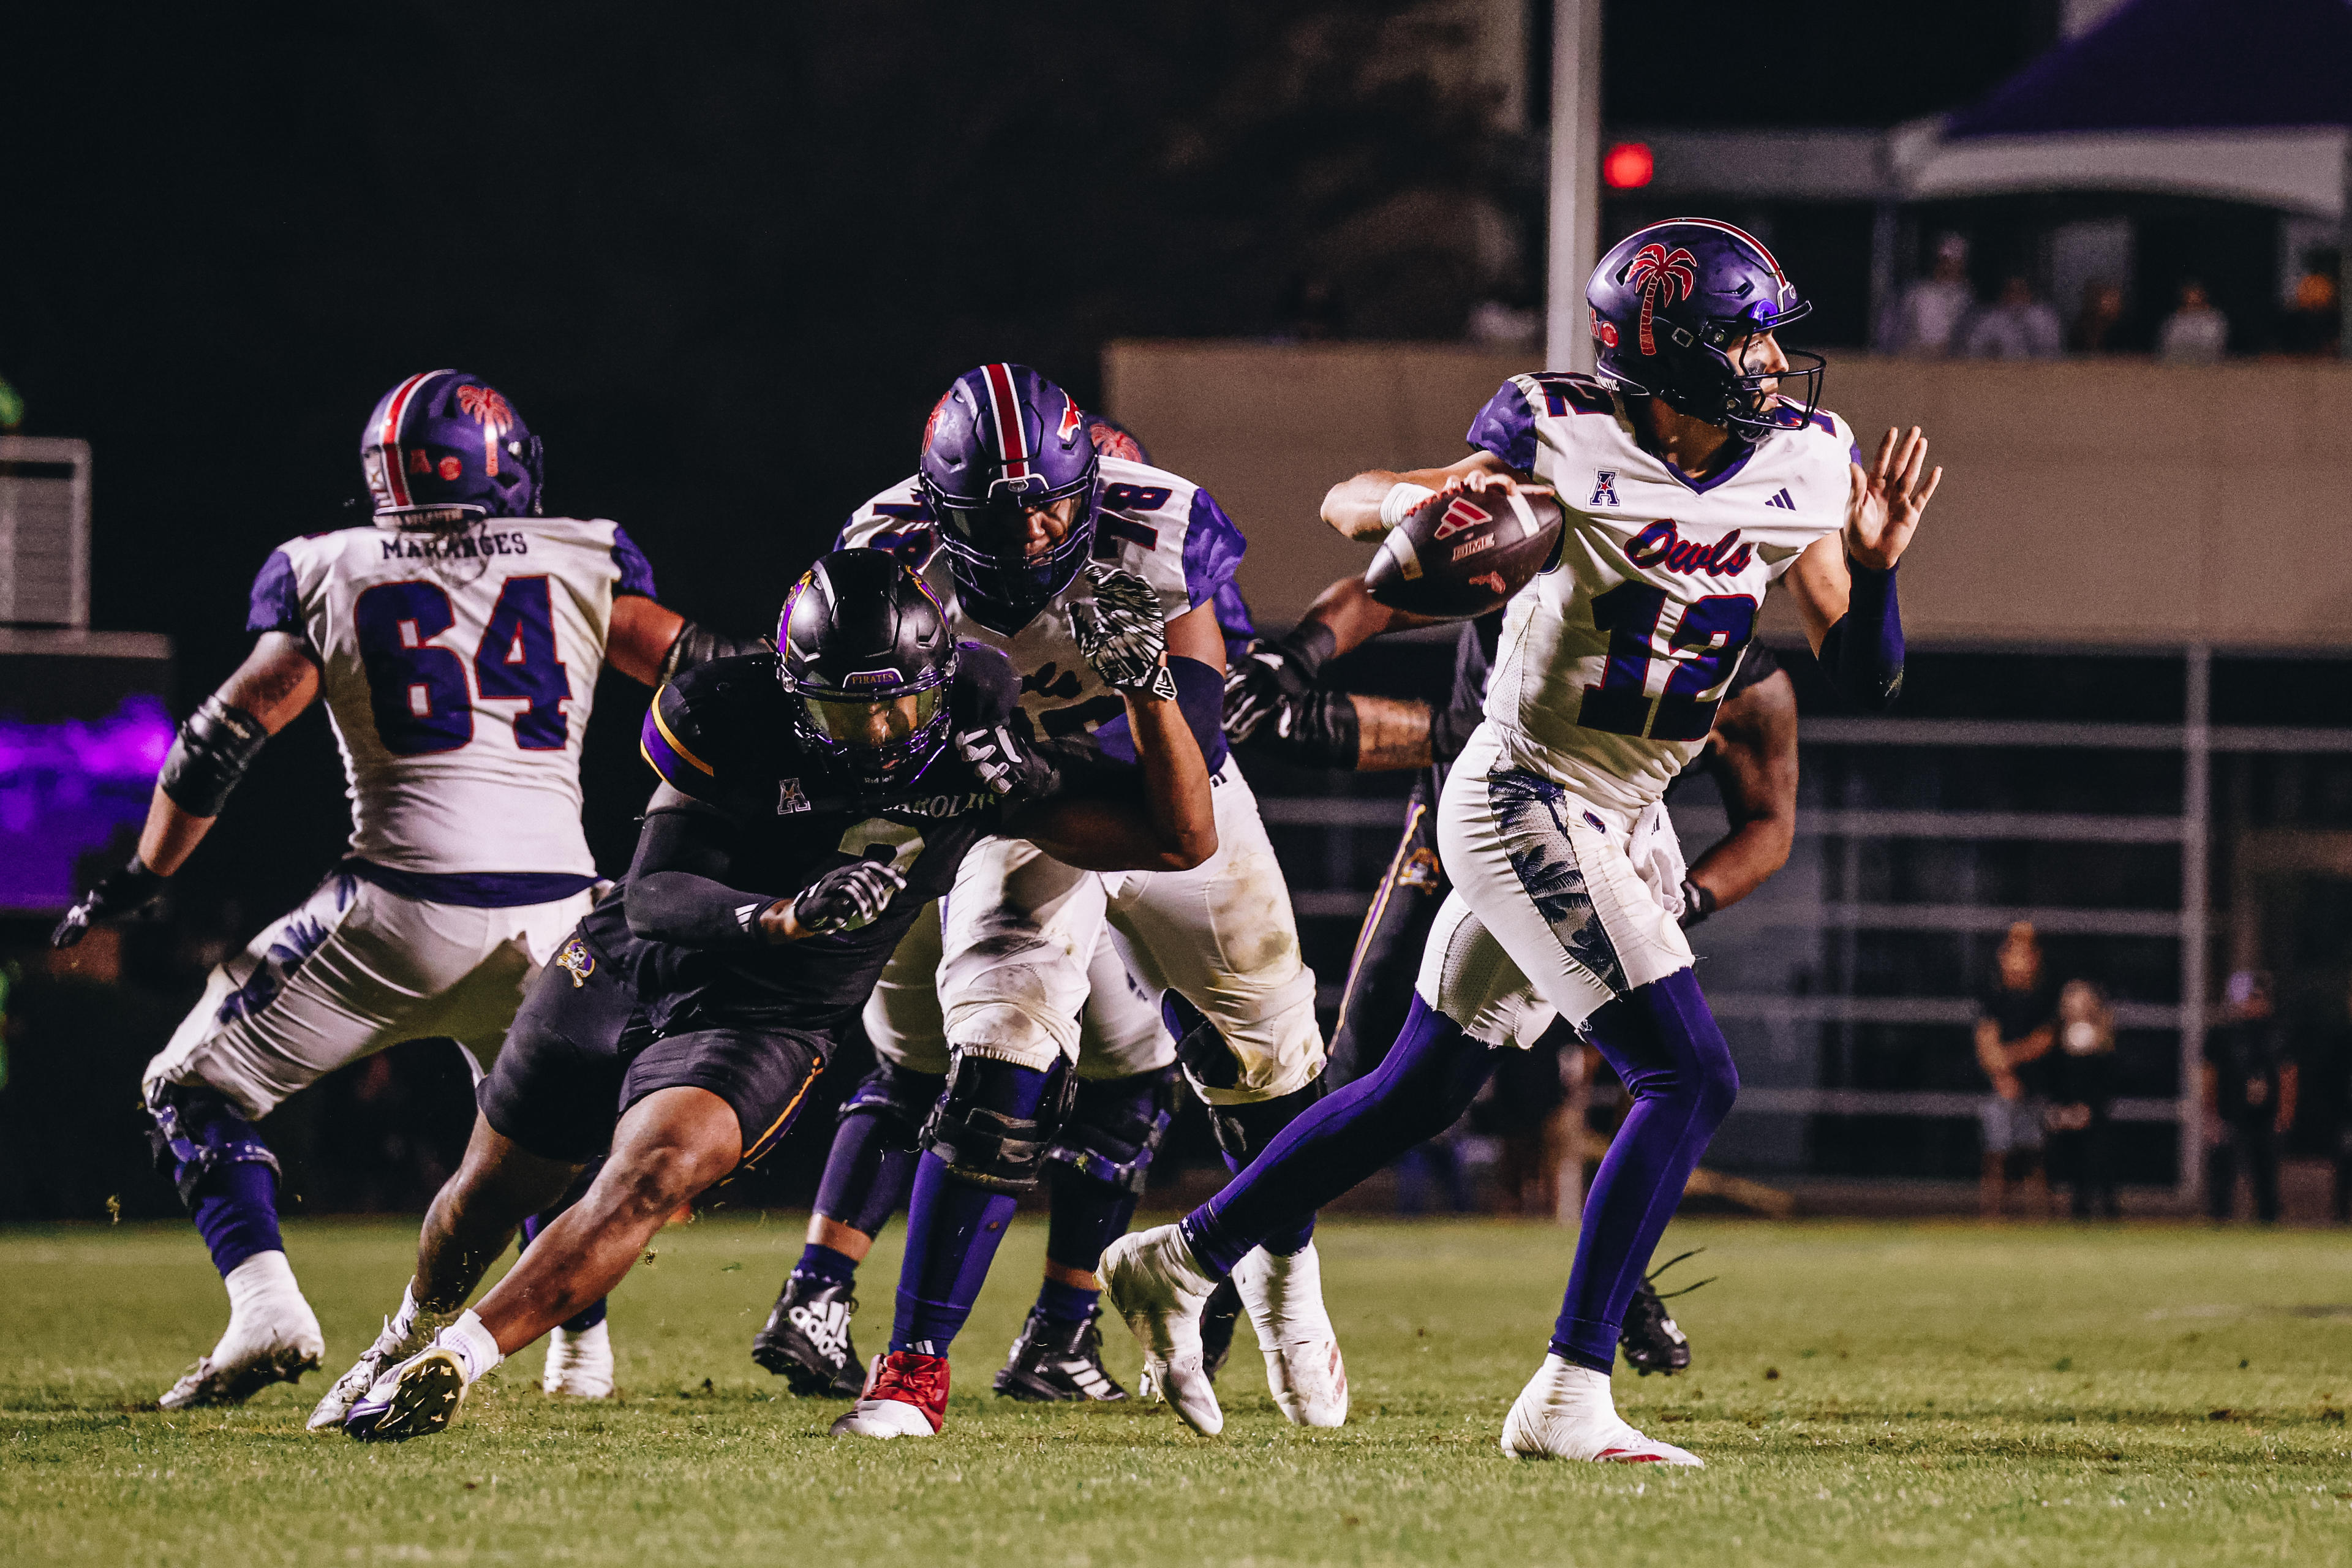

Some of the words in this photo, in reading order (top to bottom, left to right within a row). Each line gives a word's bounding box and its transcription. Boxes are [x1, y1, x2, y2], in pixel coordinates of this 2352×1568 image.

[1624, 518, 1752, 577] Owls
[354, 574, 573, 755] 64
[852, 673, 894, 685] PIRATES
[1577, 578, 1759, 742] 12
